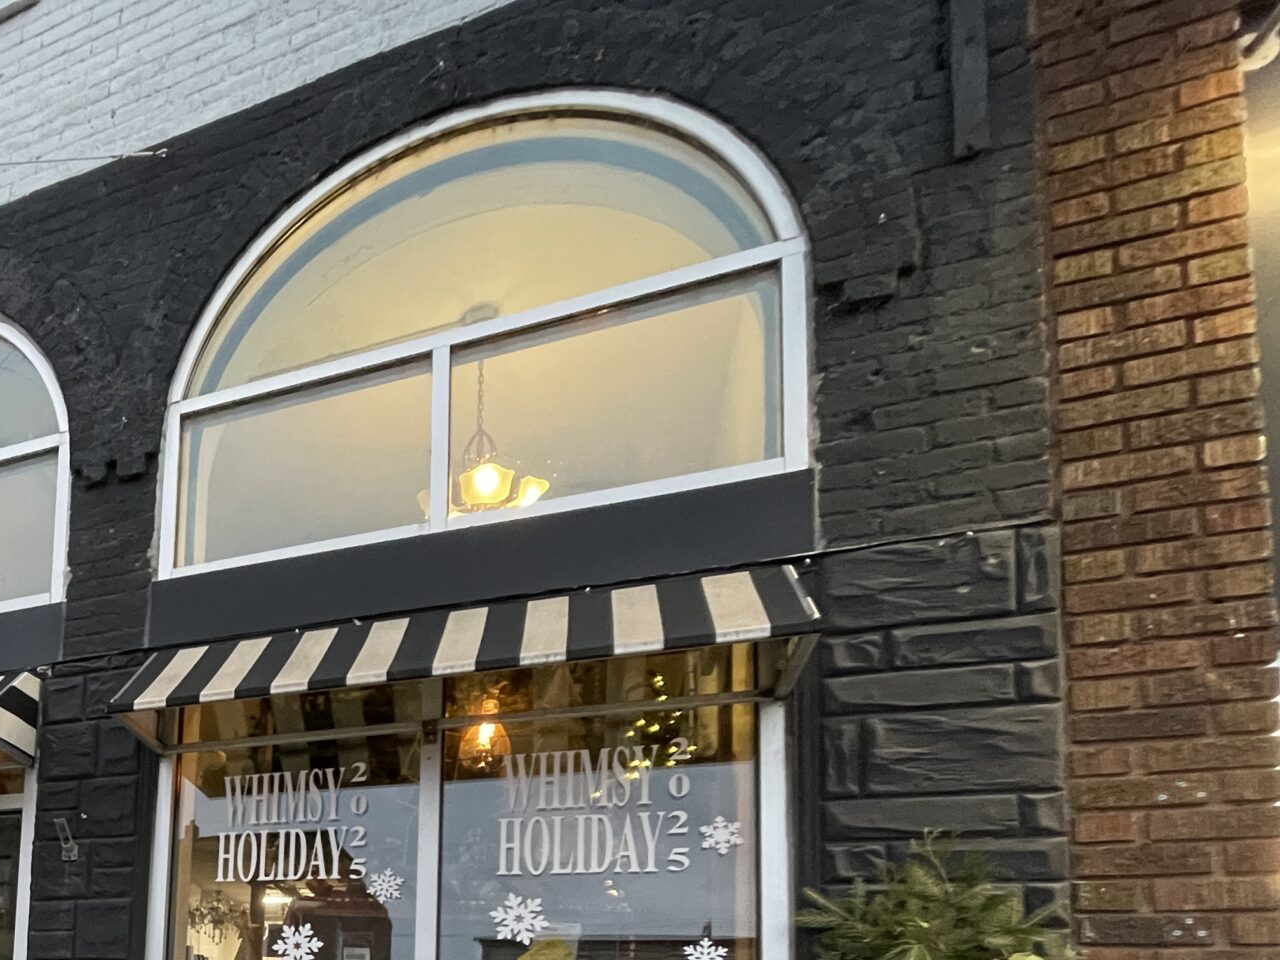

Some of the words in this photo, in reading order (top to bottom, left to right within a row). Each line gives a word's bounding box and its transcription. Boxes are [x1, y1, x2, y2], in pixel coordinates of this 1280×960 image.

[224, 767, 345, 828] WHIMSY
[503, 744, 659, 815] WHIMSY
[215, 826, 347, 883] HOLIDAY
[496, 811, 666, 877] HOLIDAY
